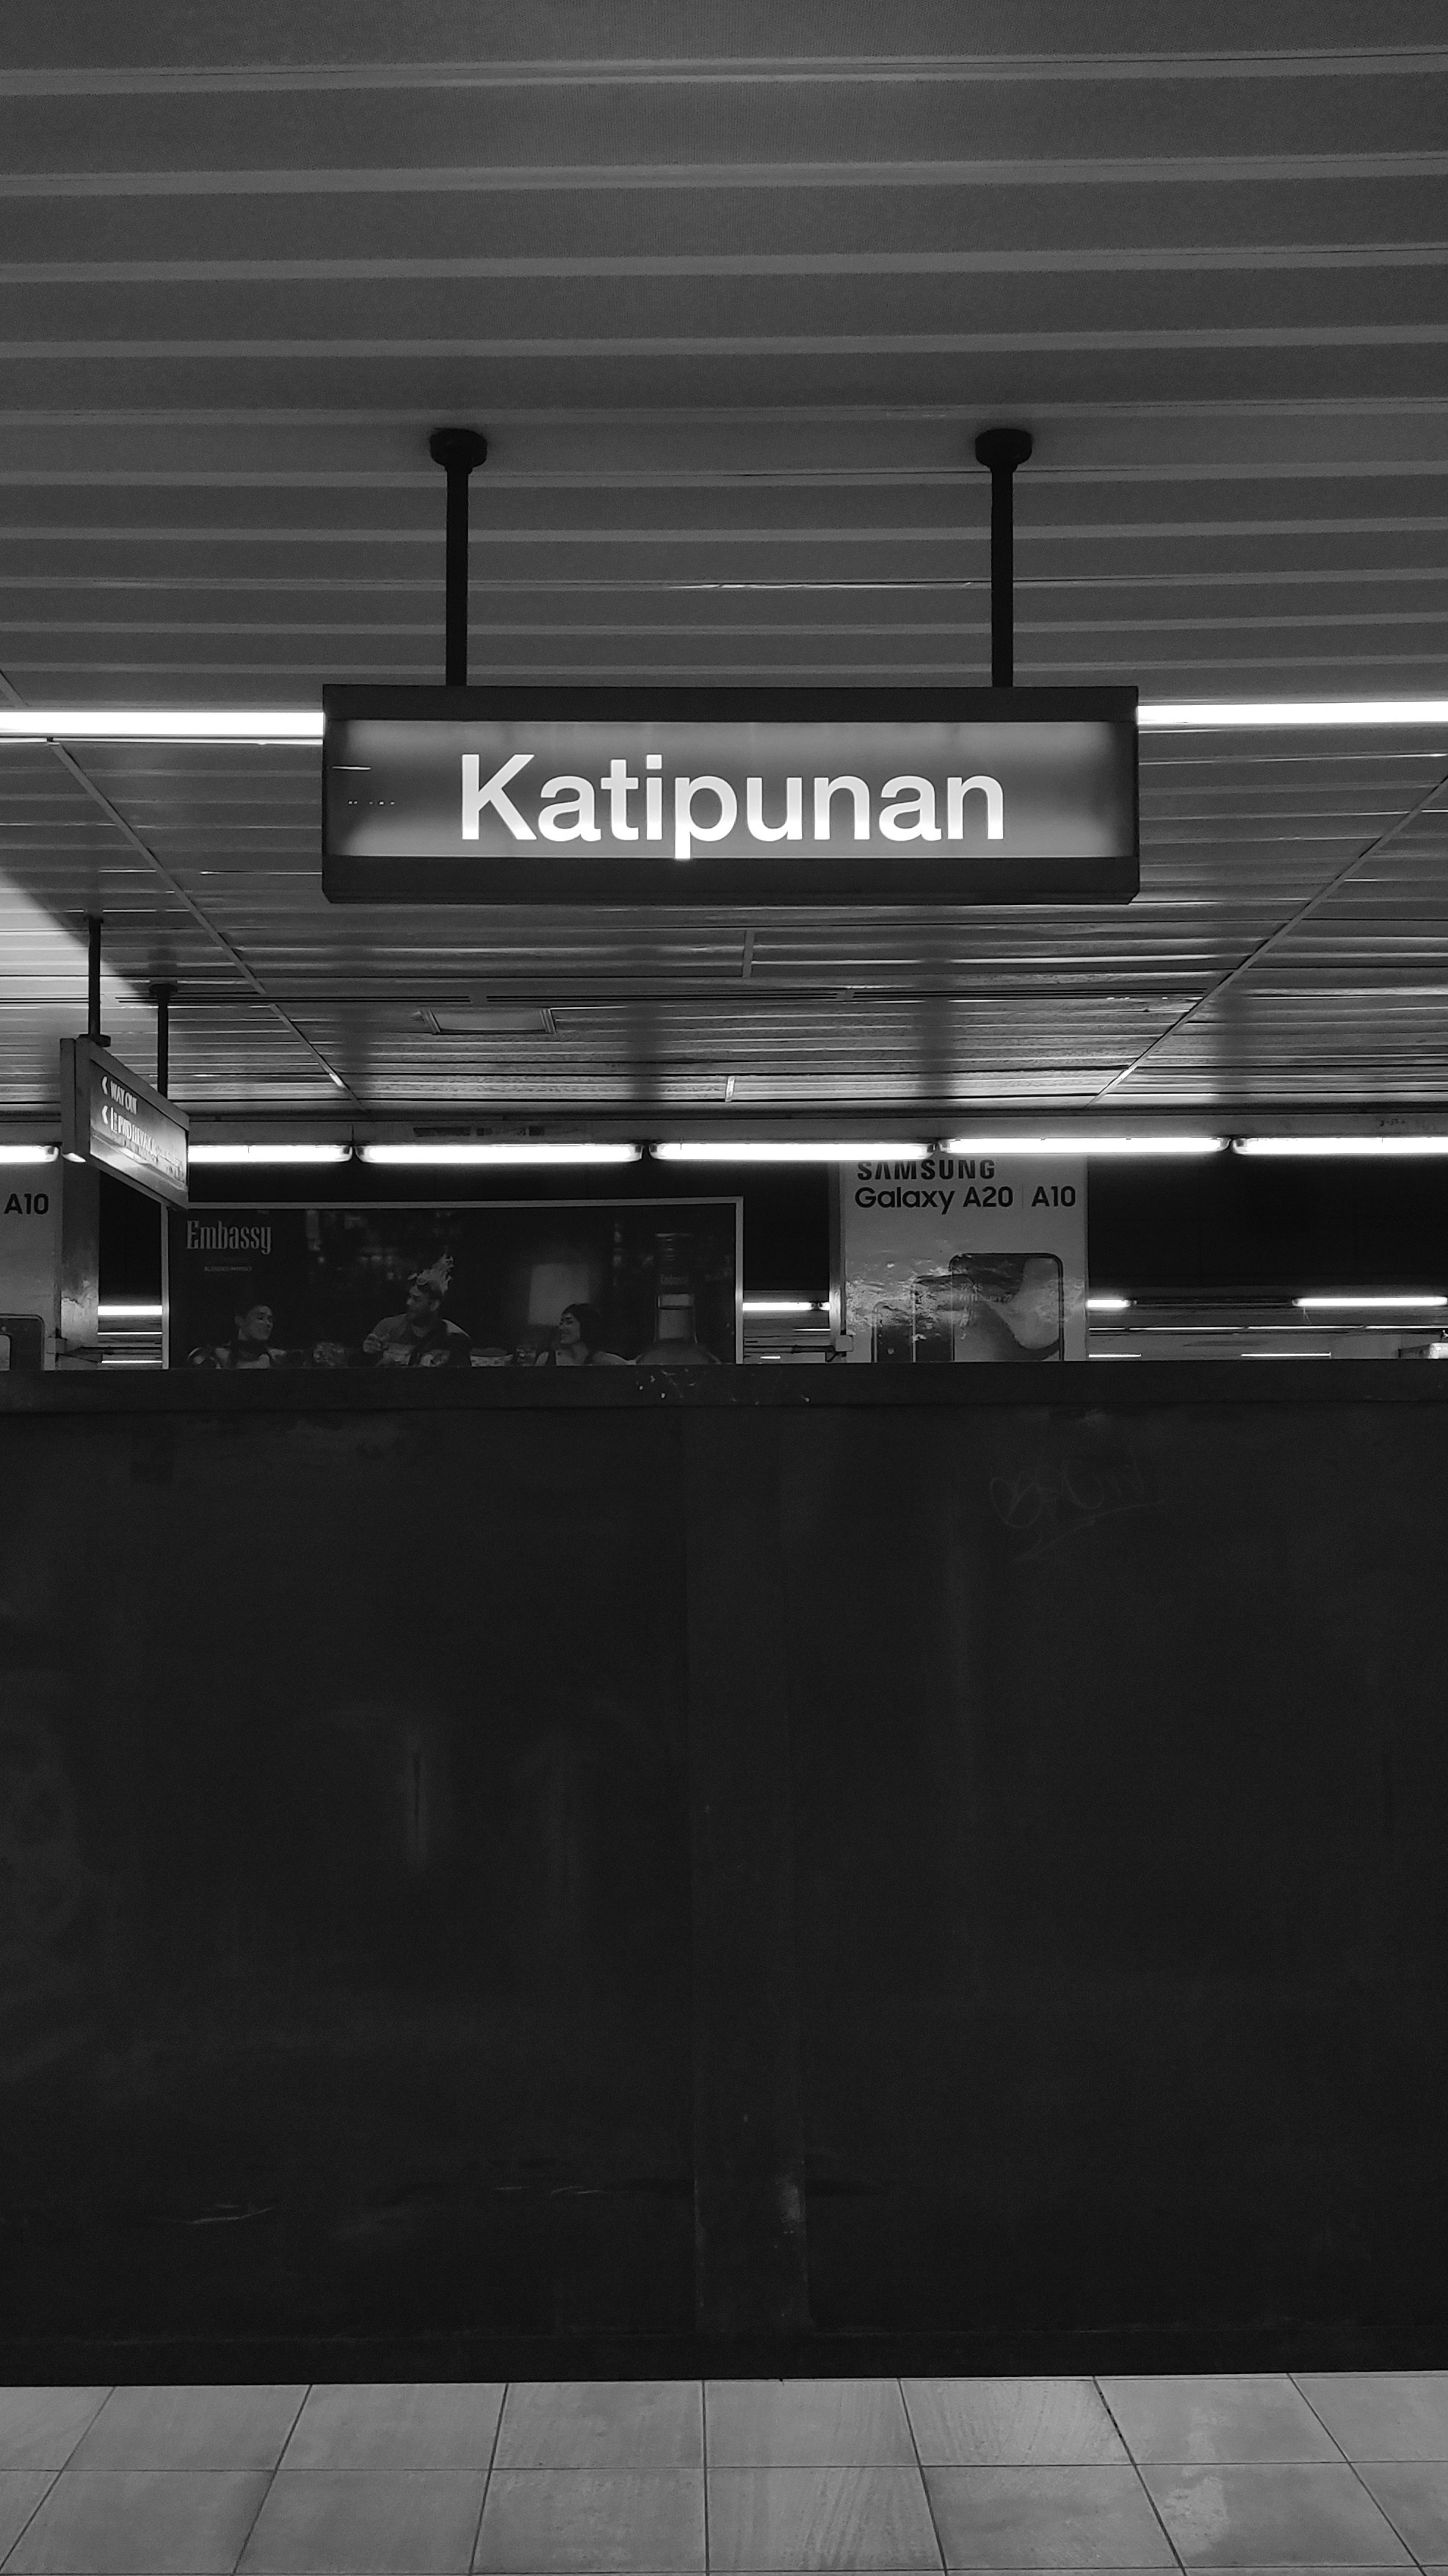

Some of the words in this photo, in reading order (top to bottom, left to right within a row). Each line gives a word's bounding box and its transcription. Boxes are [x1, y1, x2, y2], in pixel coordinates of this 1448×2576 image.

[462, 754, 1004, 859] Katipunan
[110, 1080, 125, 1106] WAY
[125, 1092, 137, 1115] OUT
[857, 1159, 995, 1180] SAMSUNG
[4, 1193, 49, 1215] A10
[855, 1186, 955, 1215] Galaxy
[963, 1186, 1013, 1208] A20
[1031, 1186, 1076, 1208] A10
[187, 1220, 272, 1255] Embassy
